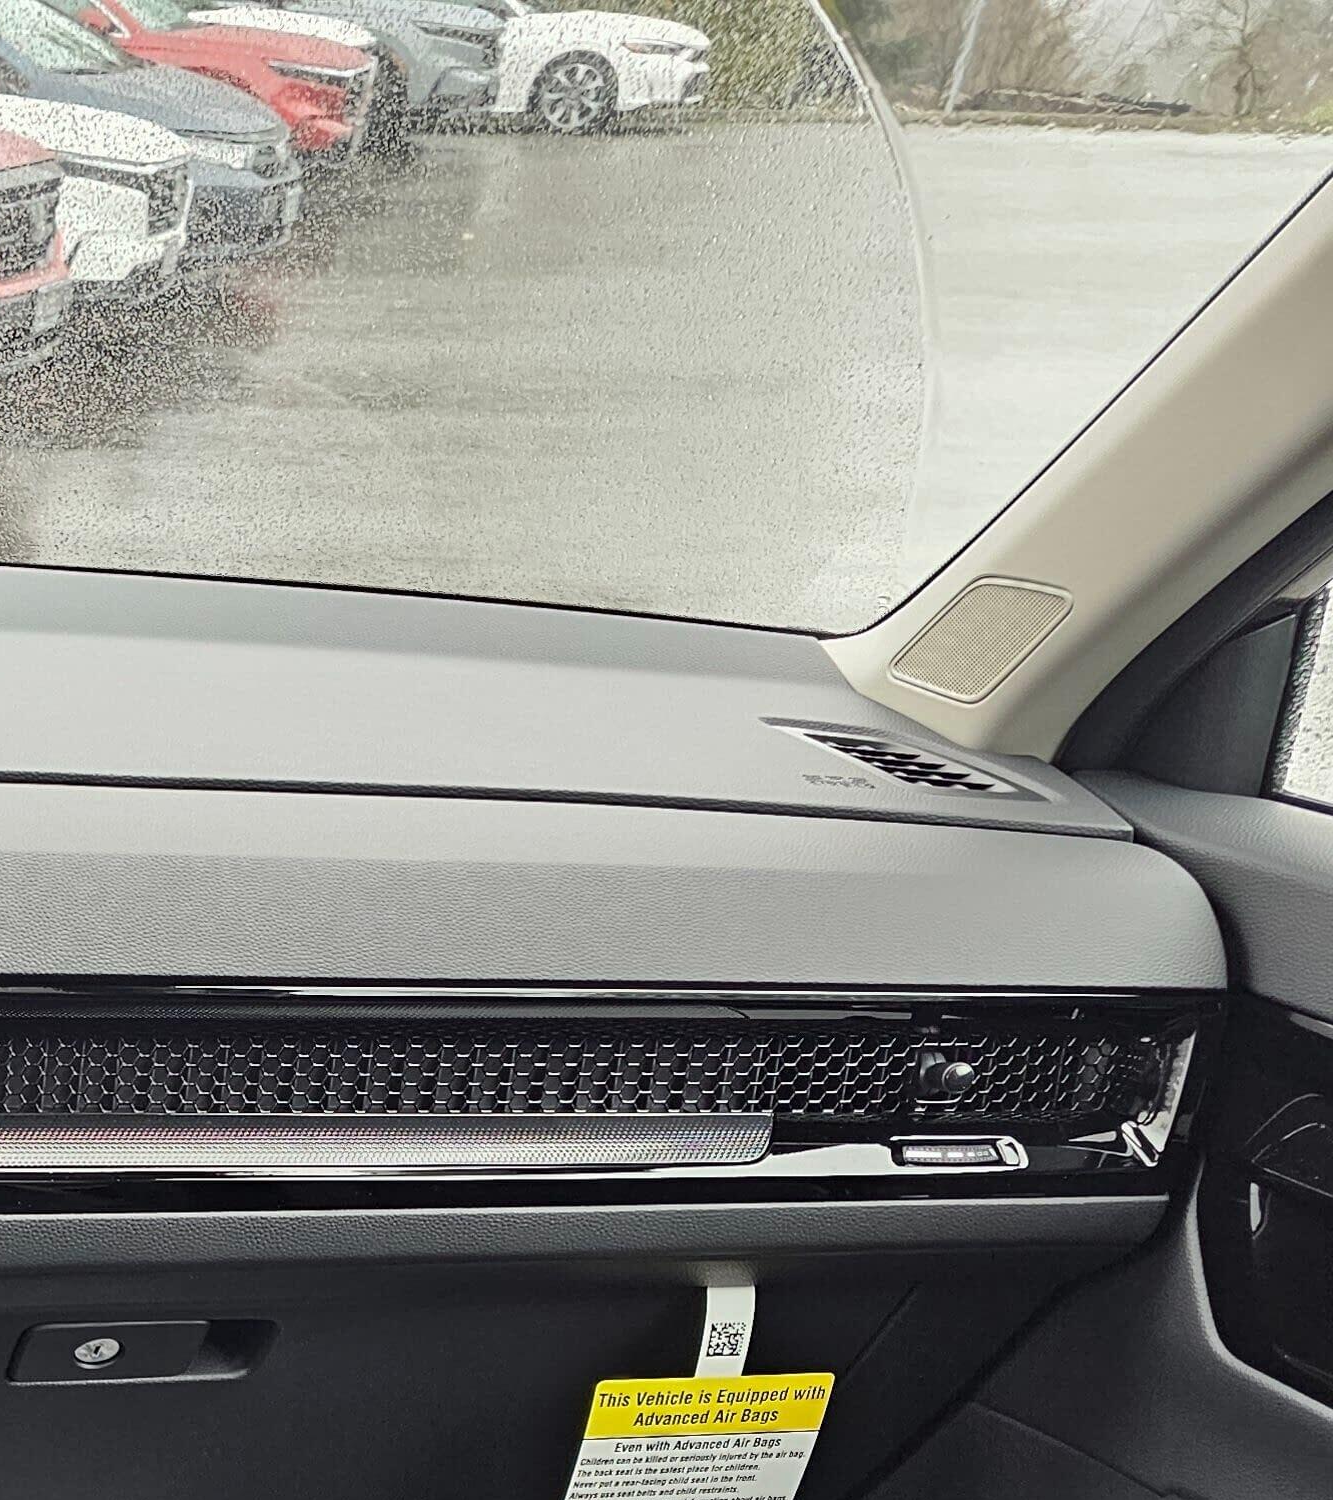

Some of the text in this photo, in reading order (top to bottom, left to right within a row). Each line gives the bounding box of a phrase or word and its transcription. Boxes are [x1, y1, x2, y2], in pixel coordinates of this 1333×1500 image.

[599, 1385, 826, 1407] This Vehicle is Equipped with
[633, 1409, 779, 1426] Advanced Air Bags
[614, 1437, 781, 1453] Even with Advanced Air Bags
[580, 1458, 614, 1466] Children
[681, 1454, 717, 1462] seriously
[719, 1452, 746, 1461] injured
[749, 1452, 759, 1460] by
[761, 1451, 773, 1459] the
[615, 1468, 633, 1476] seat
[660, 1466, 686, 1474] safest
[686, 1465, 709, 1473] place
[724, 1463, 760, 1471] children.
[598, 1481, 612, 1489] put
[622, 1478, 667, 1486] rear-facing
[691, 1476, 709, 1484] seat
[569, 1492, 598, 1500] Always
